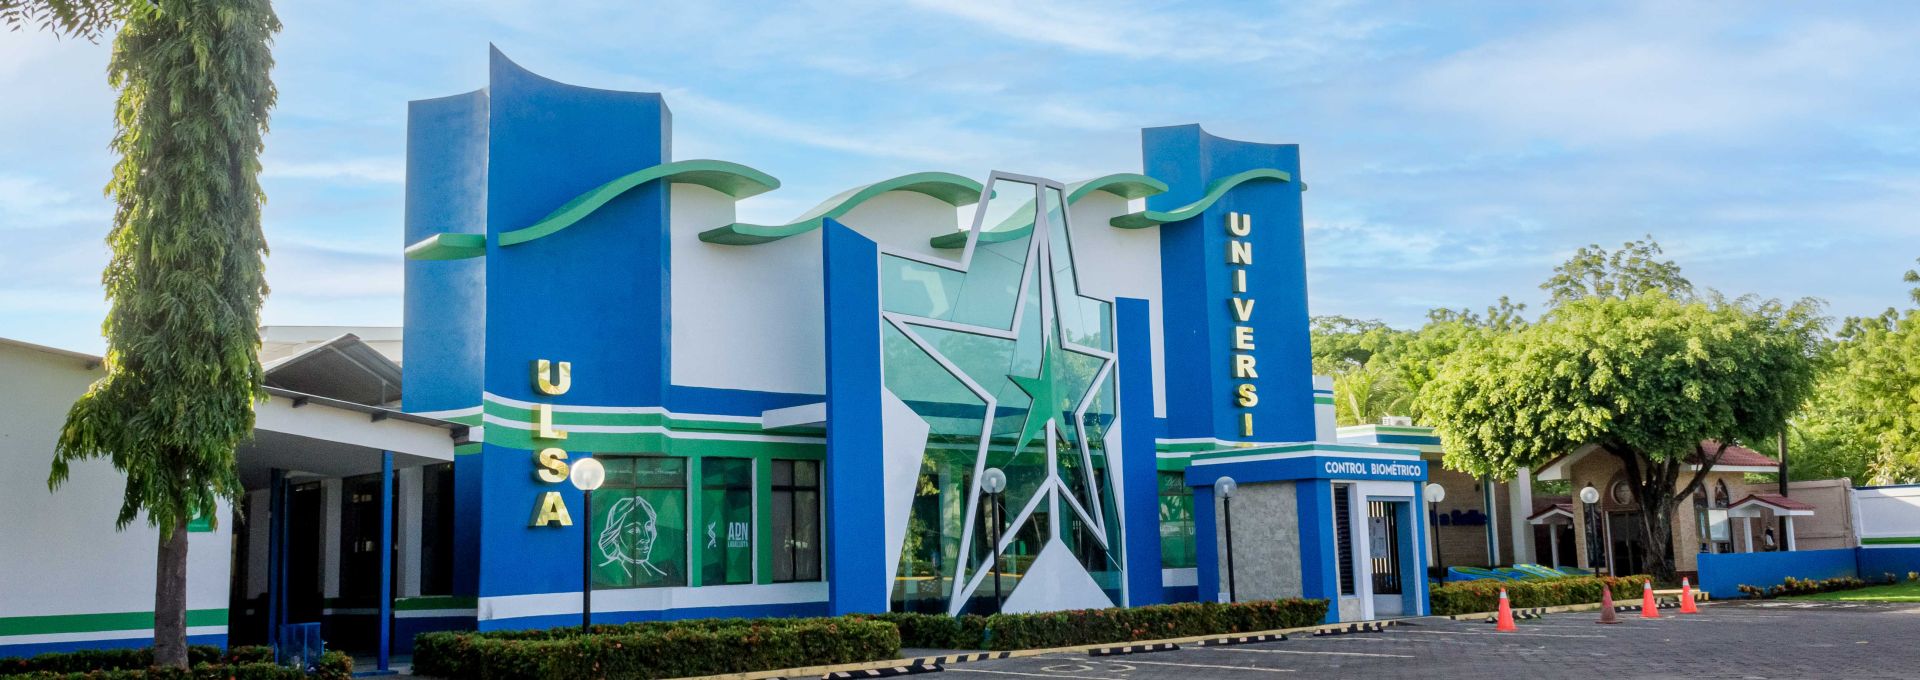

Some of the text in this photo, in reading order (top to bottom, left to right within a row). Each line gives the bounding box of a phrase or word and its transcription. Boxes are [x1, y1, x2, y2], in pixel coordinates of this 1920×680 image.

[1226, 212, 1258, 447] UNIVERSI
[530, 359, 573, 527] ULSA
[1325, 461, 1421, 476] CONTROL BIOMÉTRICO
[728, 522, 748, 540] ADN
